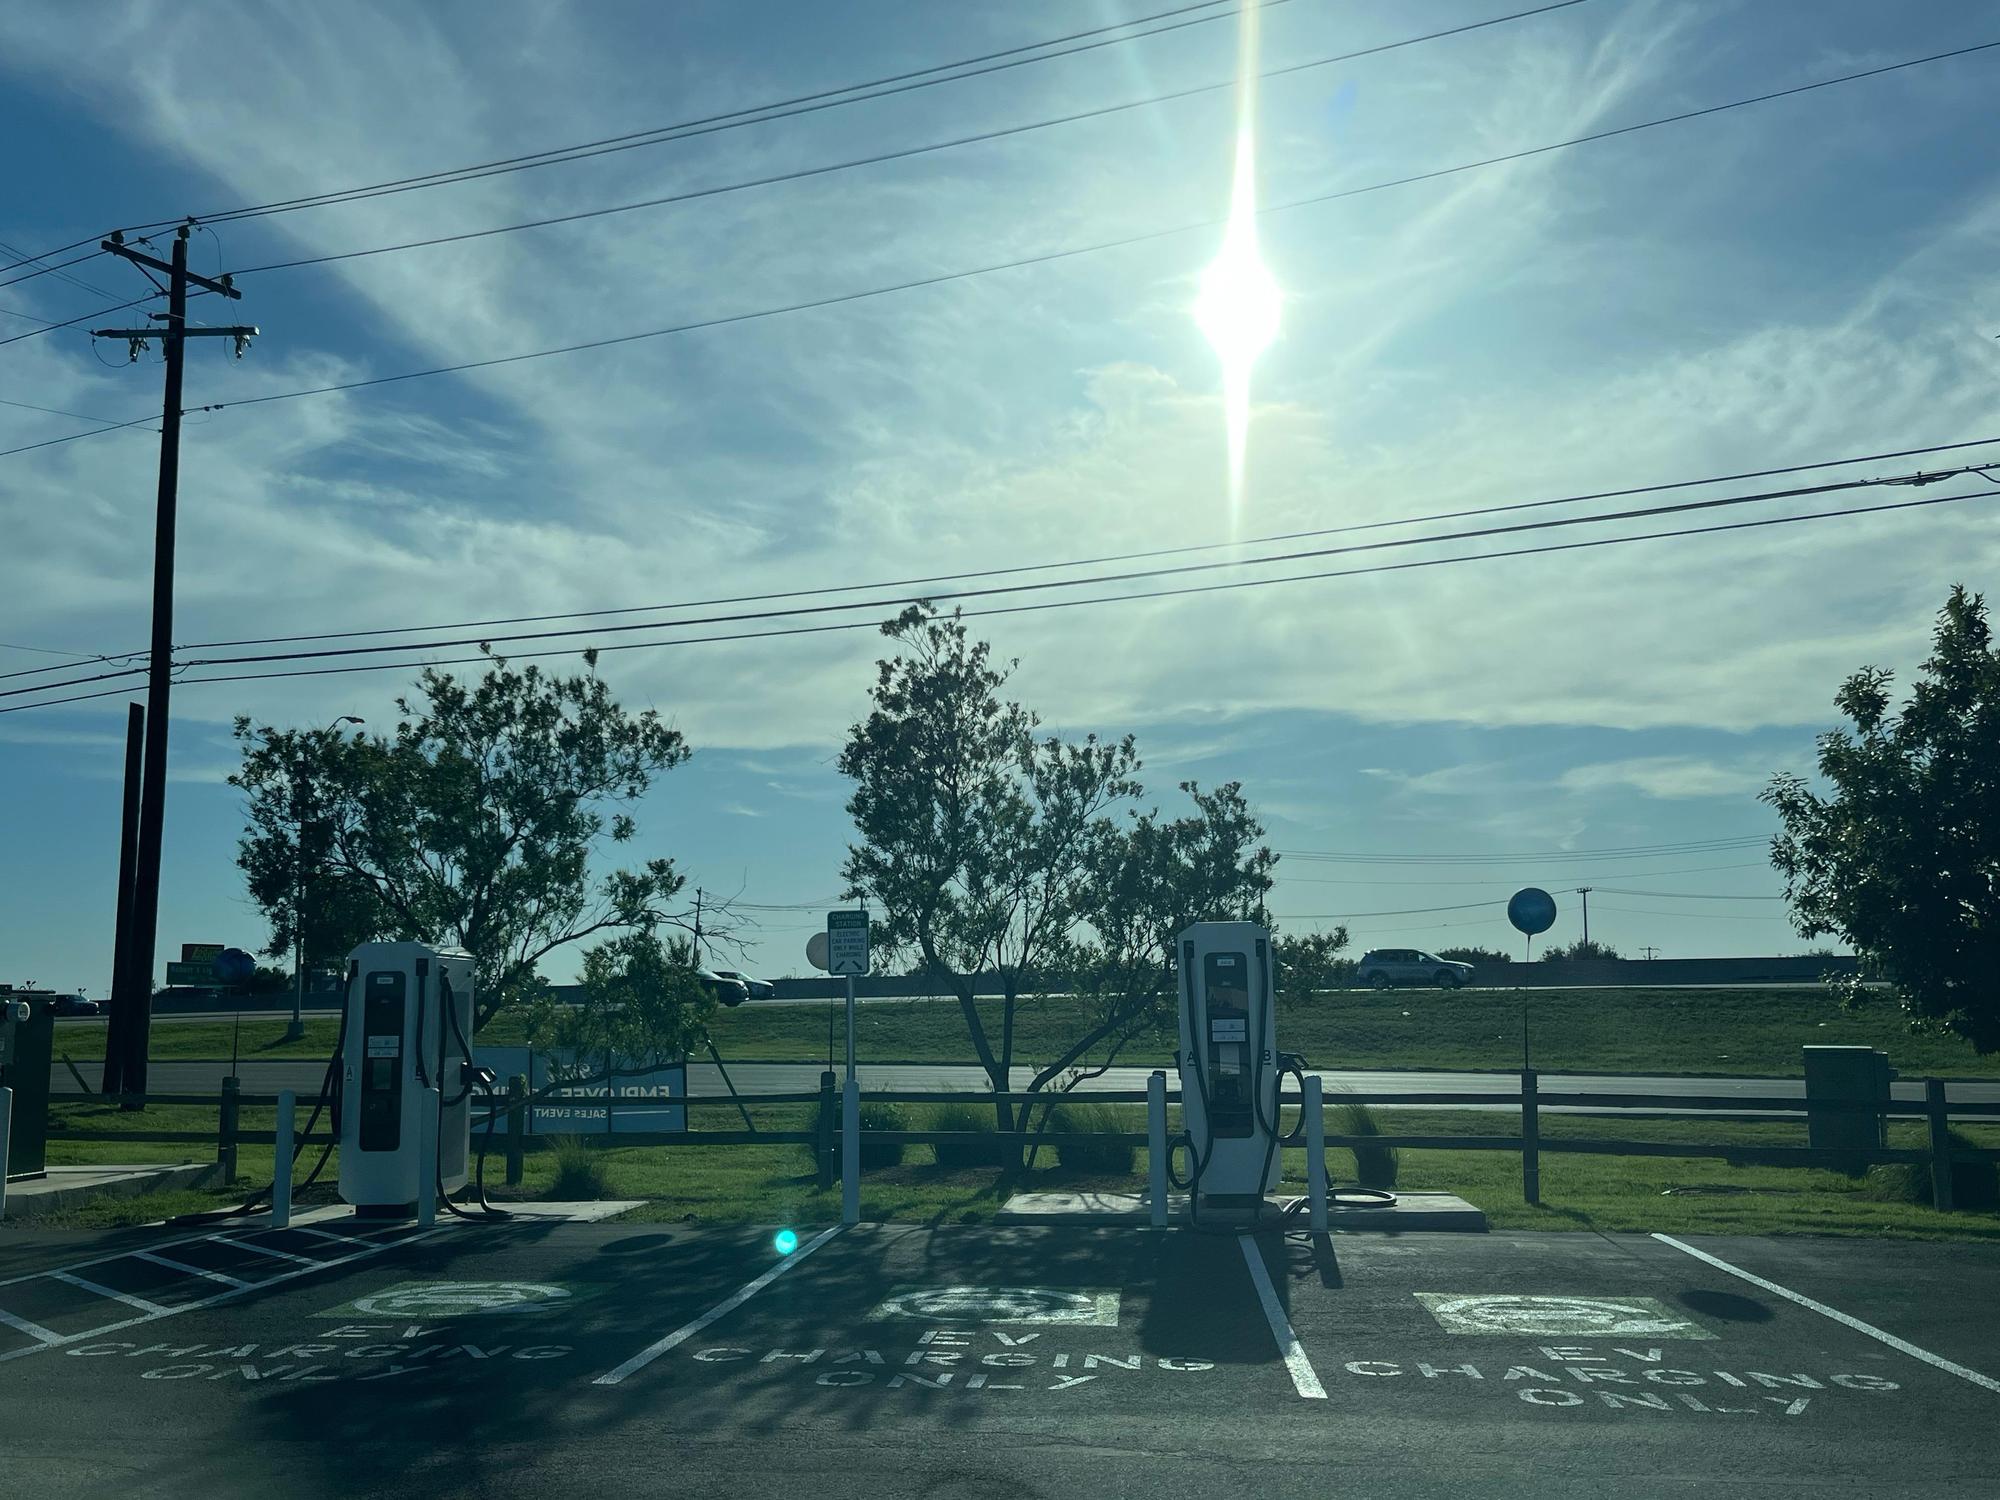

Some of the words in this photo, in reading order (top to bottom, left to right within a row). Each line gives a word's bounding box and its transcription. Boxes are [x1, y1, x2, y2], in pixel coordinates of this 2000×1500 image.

[835, 920, 862, 928] STATION
[317, 1325, 454, 1338] EV
[917, 1330, 1041, 1346] EV
[65, 1342, 576, 1359] CHARGING
[1538, 1346, 1663, 1361] EV
[692, 1347, 1215, 1372] CHARGING
[141, 1363, 429, 1381] ONLY
[815, 1370, 1098, 1391] ONLY
[1344, 1360, 1901, 1391] CHARGING
[1517, 1388, 1811, 1415] ONLY
